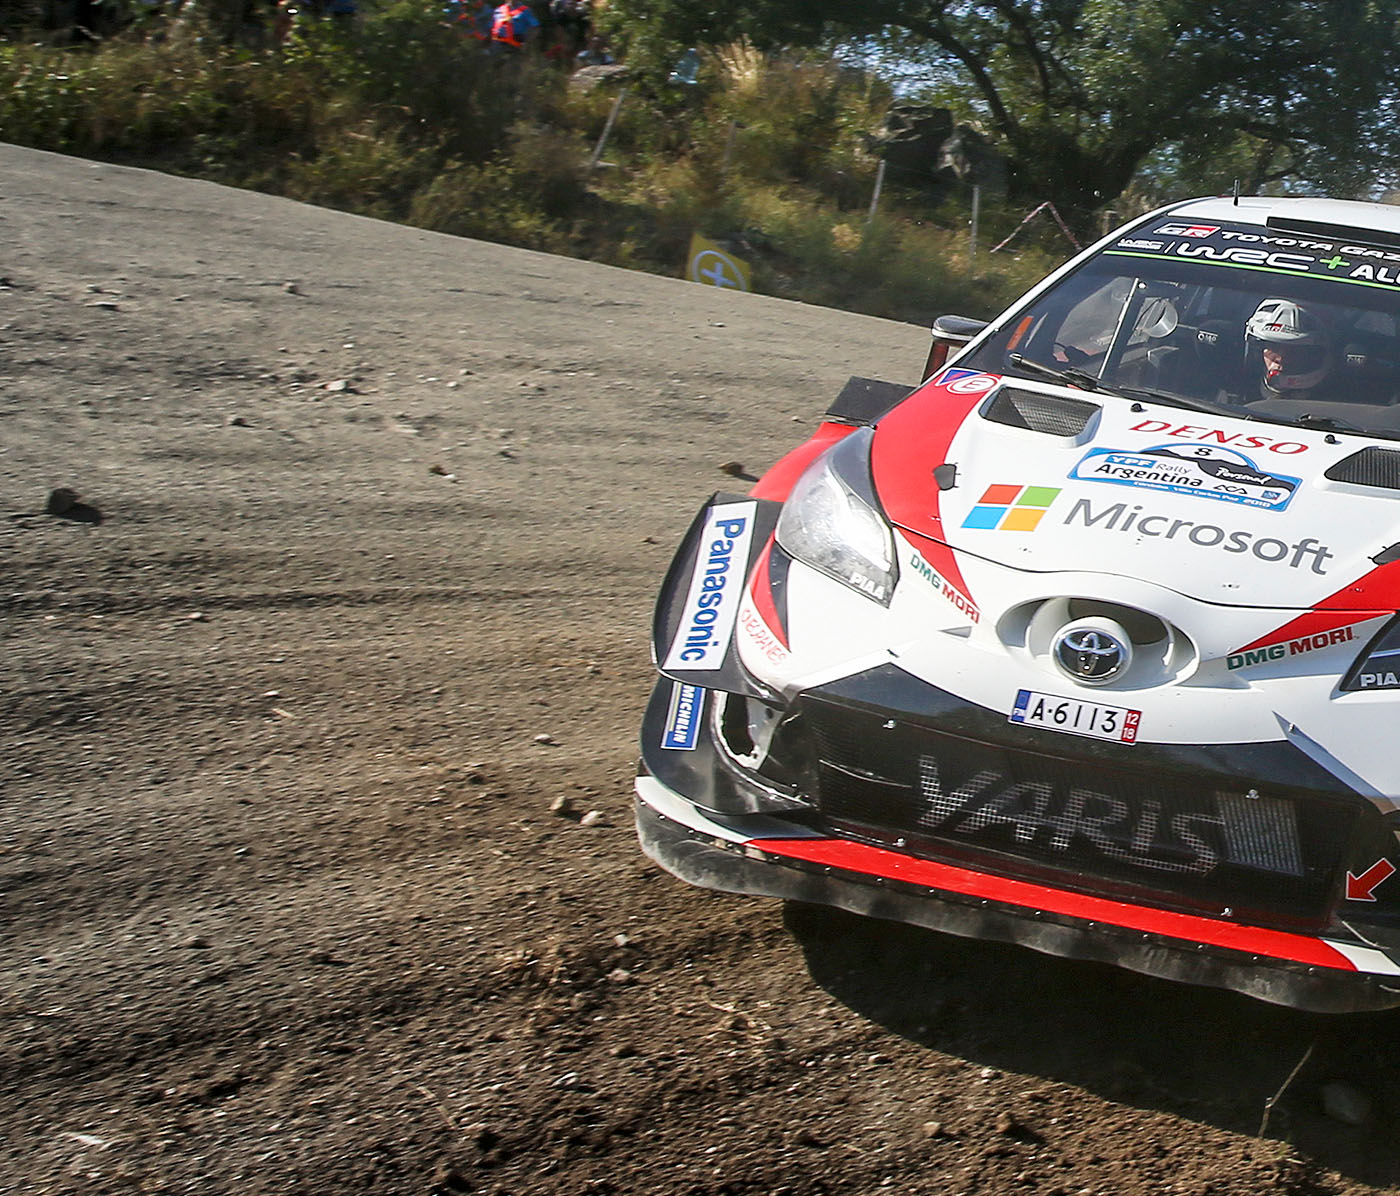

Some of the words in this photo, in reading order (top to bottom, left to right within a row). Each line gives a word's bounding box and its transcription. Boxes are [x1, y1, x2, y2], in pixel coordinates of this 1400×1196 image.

[1221, 231, 1334, 251] TOYOTA
[1128, 419, 1309, 455] DENSO
[1094, 463, 1203, 487] Argentina
[1111, 456, 1154, 467] YPF
[1156, 463, 1192, 475] Rally
[1242, 498, 1271, 508] 2018
[1063, 498, 1334, 576] Microsoft
[680, 517, 747, 662] Panasonic
[850, 571, 886, 600] PIAA
[910, 554, 942, 590] DMG
[941, 583, 981, 625] MORI
[1226, 645, 1285, 671] DMG
[1289, 626, 1353, 655] MORI
[673, 684, 695, 744] MICHELIN
[1126, 712, 1140, 726] 12
[917, 753, 1225, 875] YARIS
